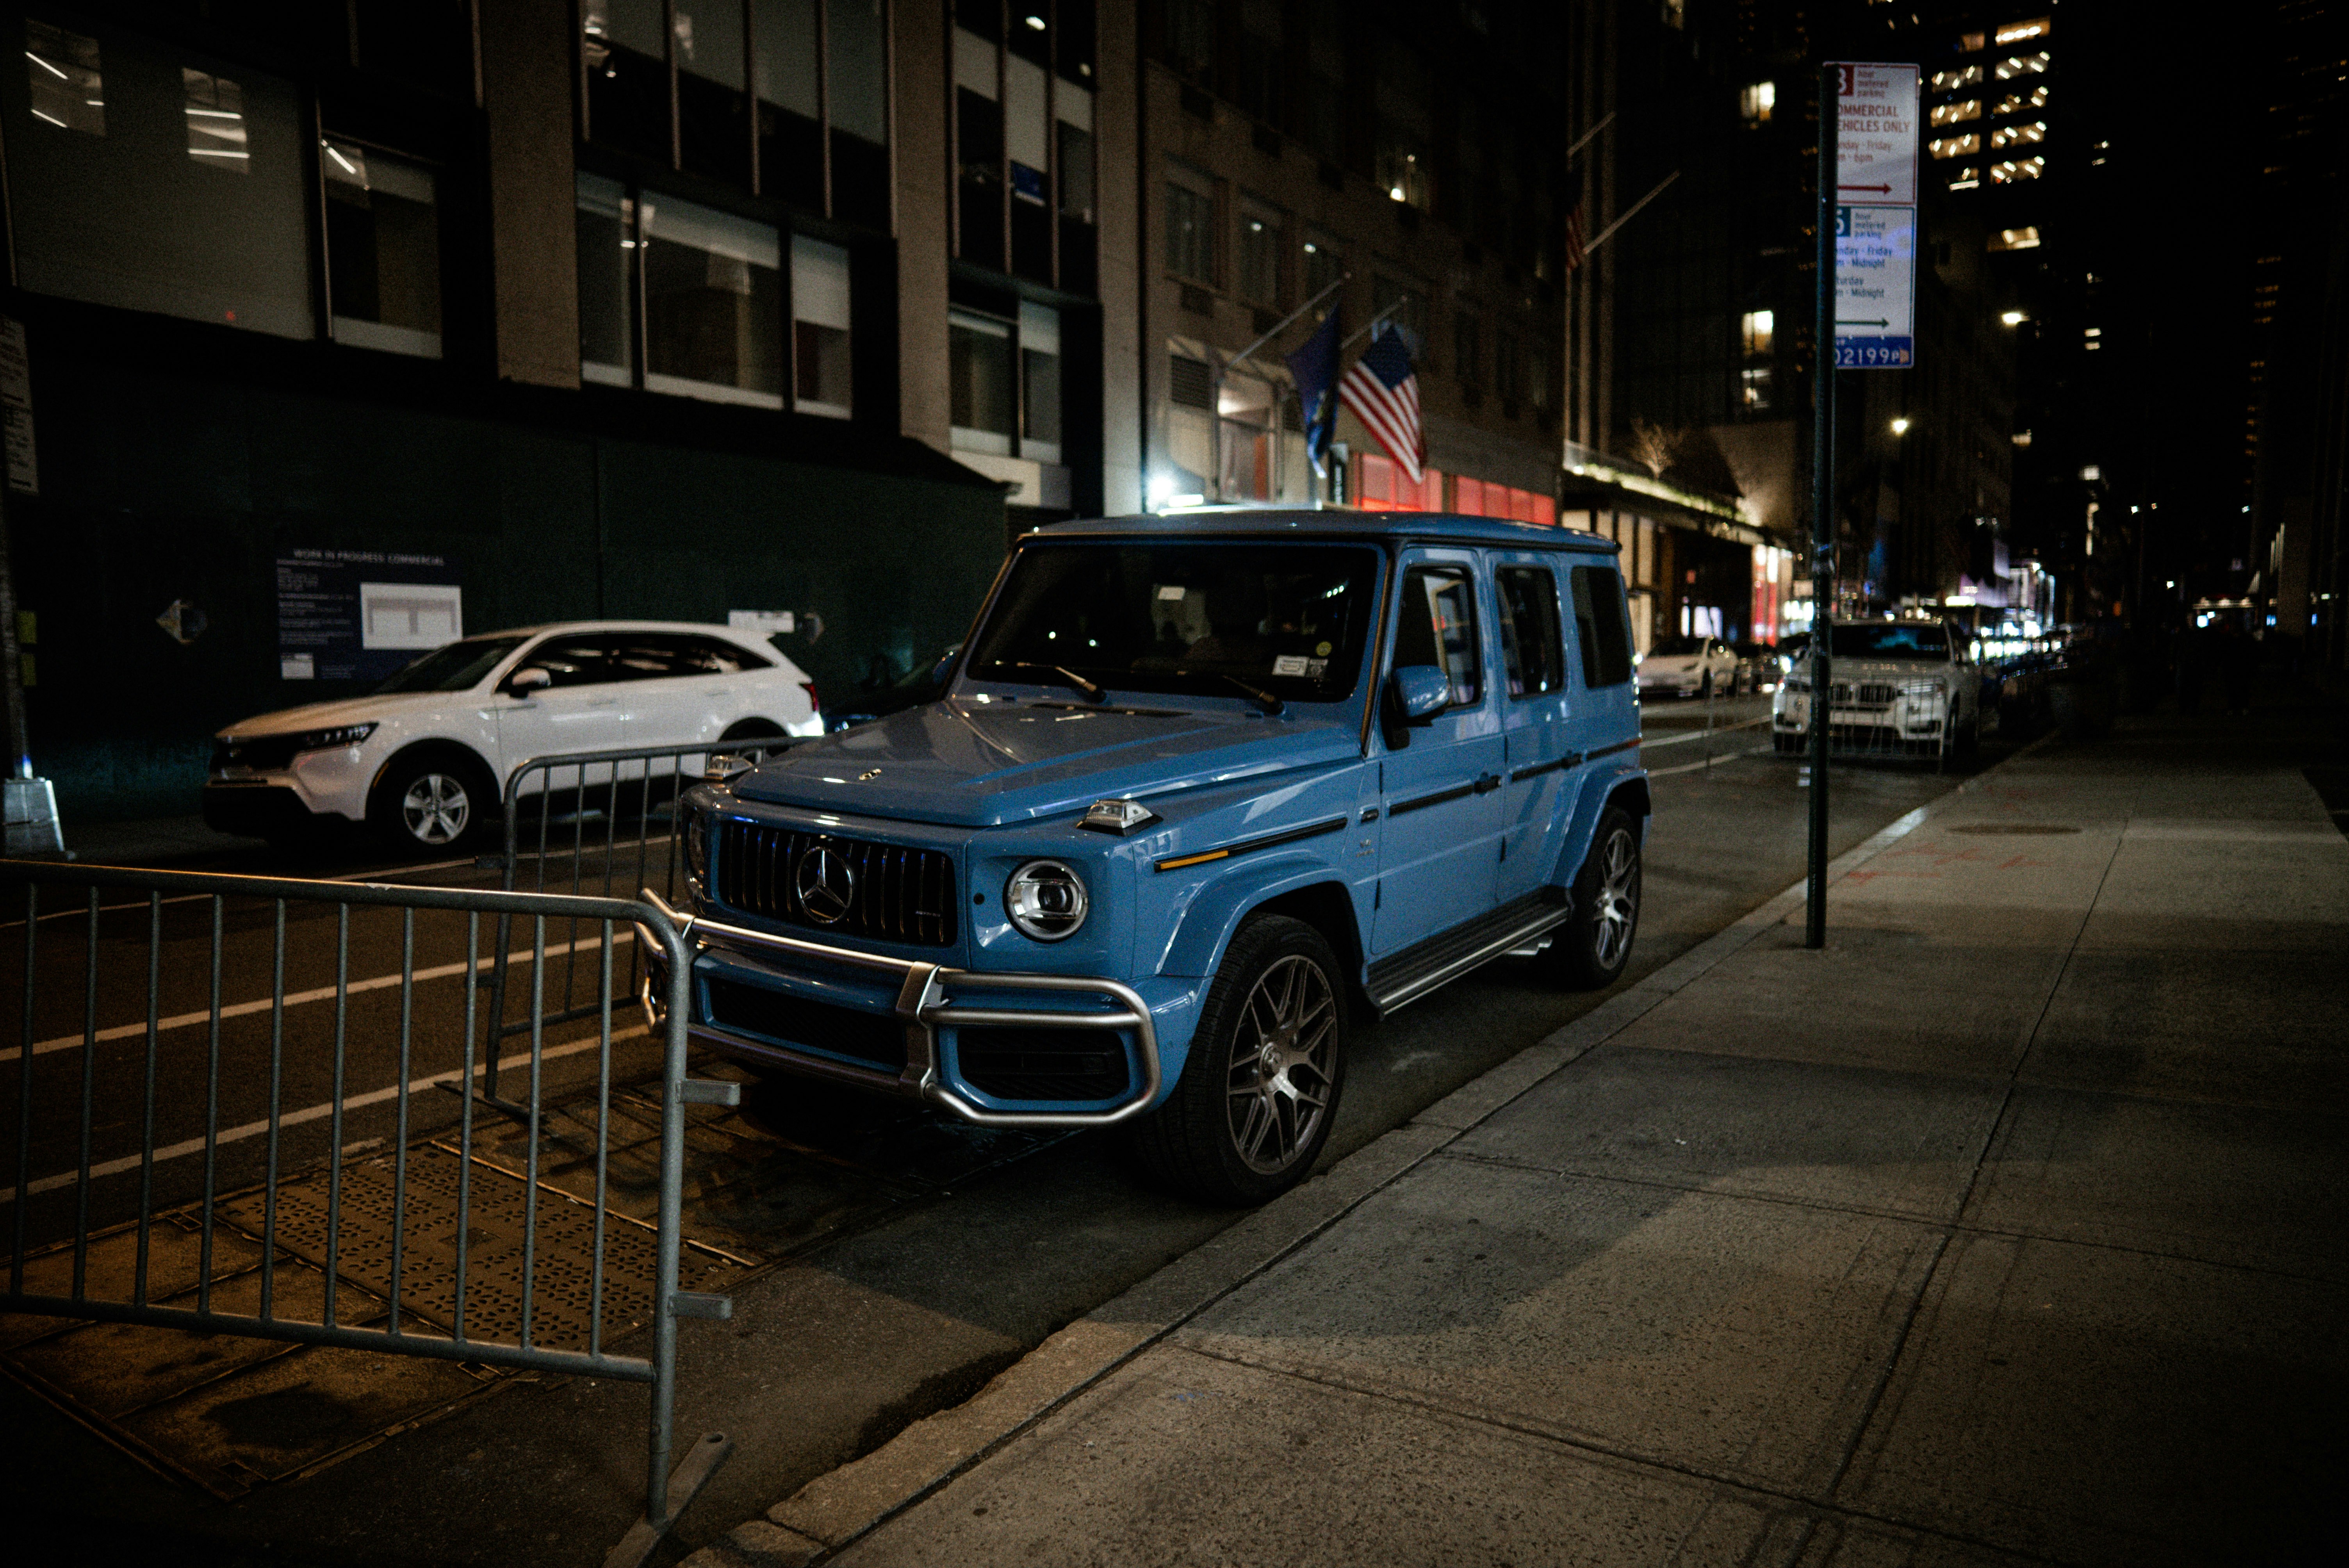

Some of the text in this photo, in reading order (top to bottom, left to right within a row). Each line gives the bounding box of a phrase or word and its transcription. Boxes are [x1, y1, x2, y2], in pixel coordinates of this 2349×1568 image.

[1838, 104, 1898, 118] OMMERCIAL
[1838, 119, 1910, 133] EHICLES ONLY
[1852, 258, 1885, 269] Midnight
